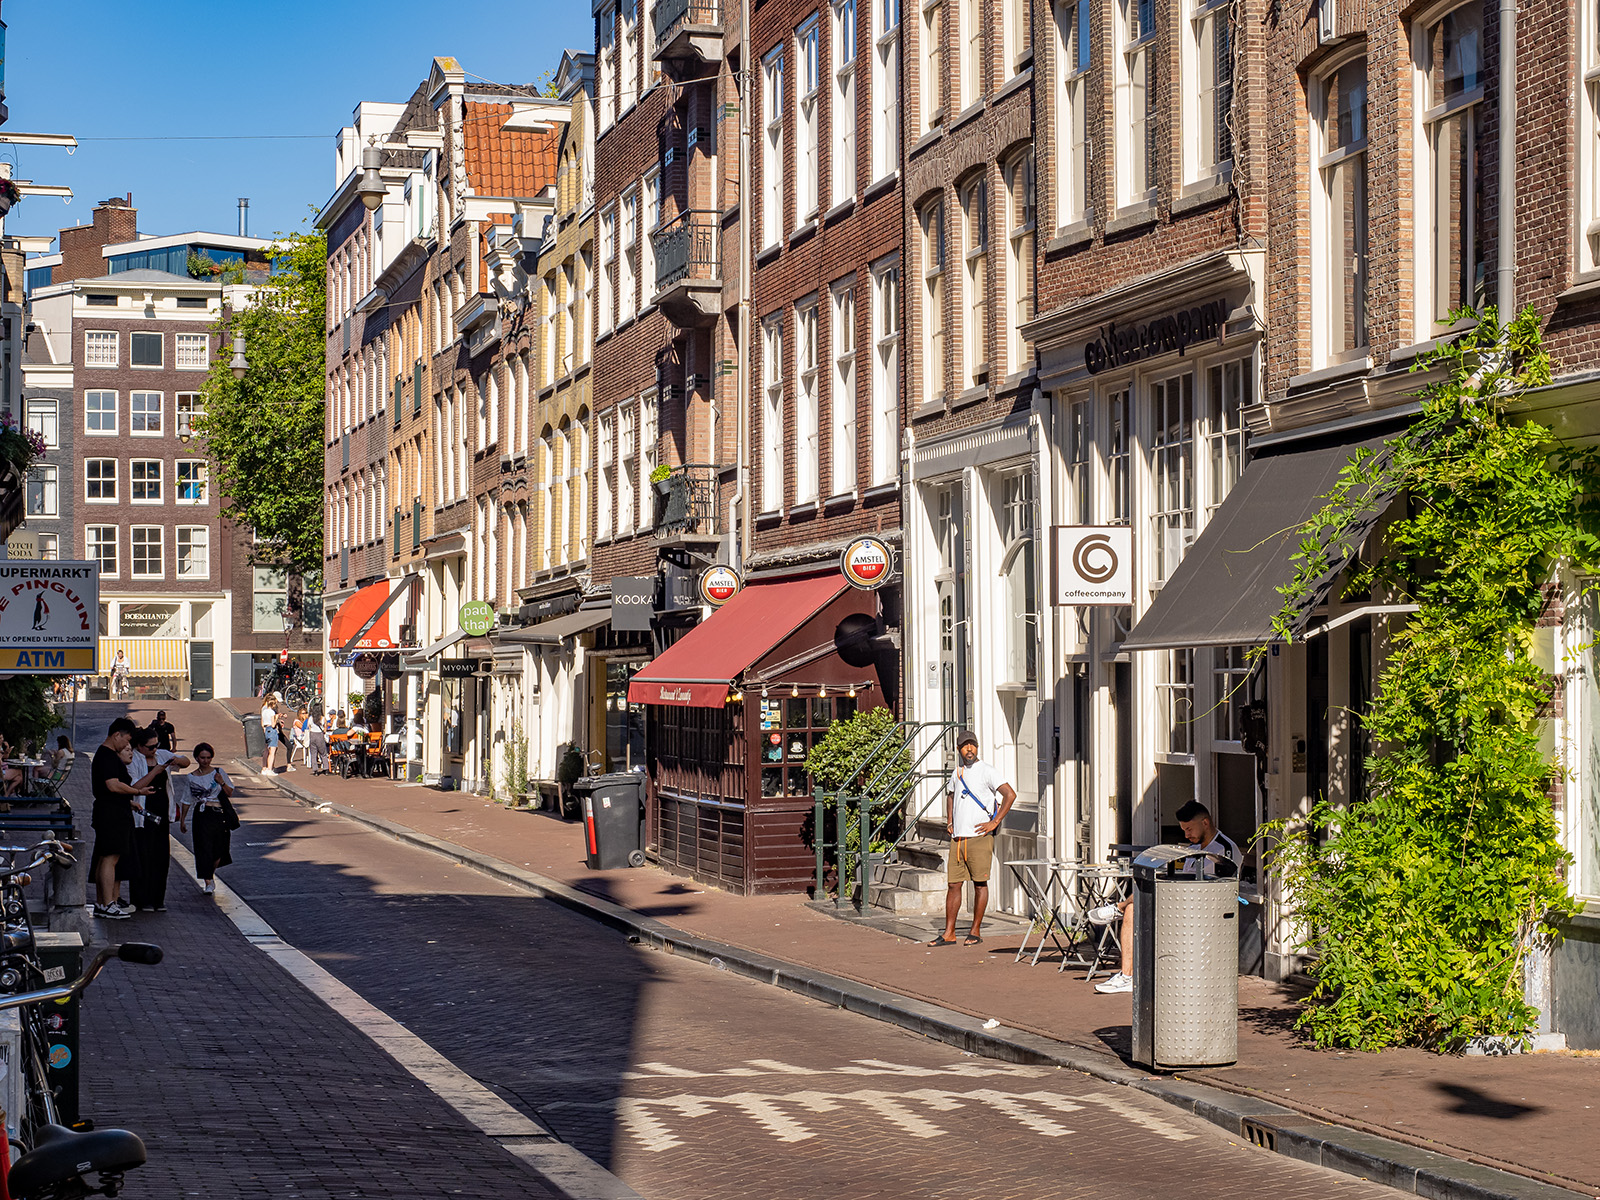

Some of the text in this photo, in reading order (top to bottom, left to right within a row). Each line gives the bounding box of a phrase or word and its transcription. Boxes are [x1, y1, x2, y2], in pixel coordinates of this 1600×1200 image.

[8, 542, 33, 550] OTCH
[854, 555, 883, 564] AMSTEL
[0, 567, 91, 579] UPERMARKT
[1064, 589, 1126, 599] coffeecompany
[11, 579, 90, 630] PINGUIN
[464, 604, 488, 619] pad
[464, 617, 490, 631] thai
[16, 650, 65, 667] ATM
[442, 664, 475, 672] MYOMY
